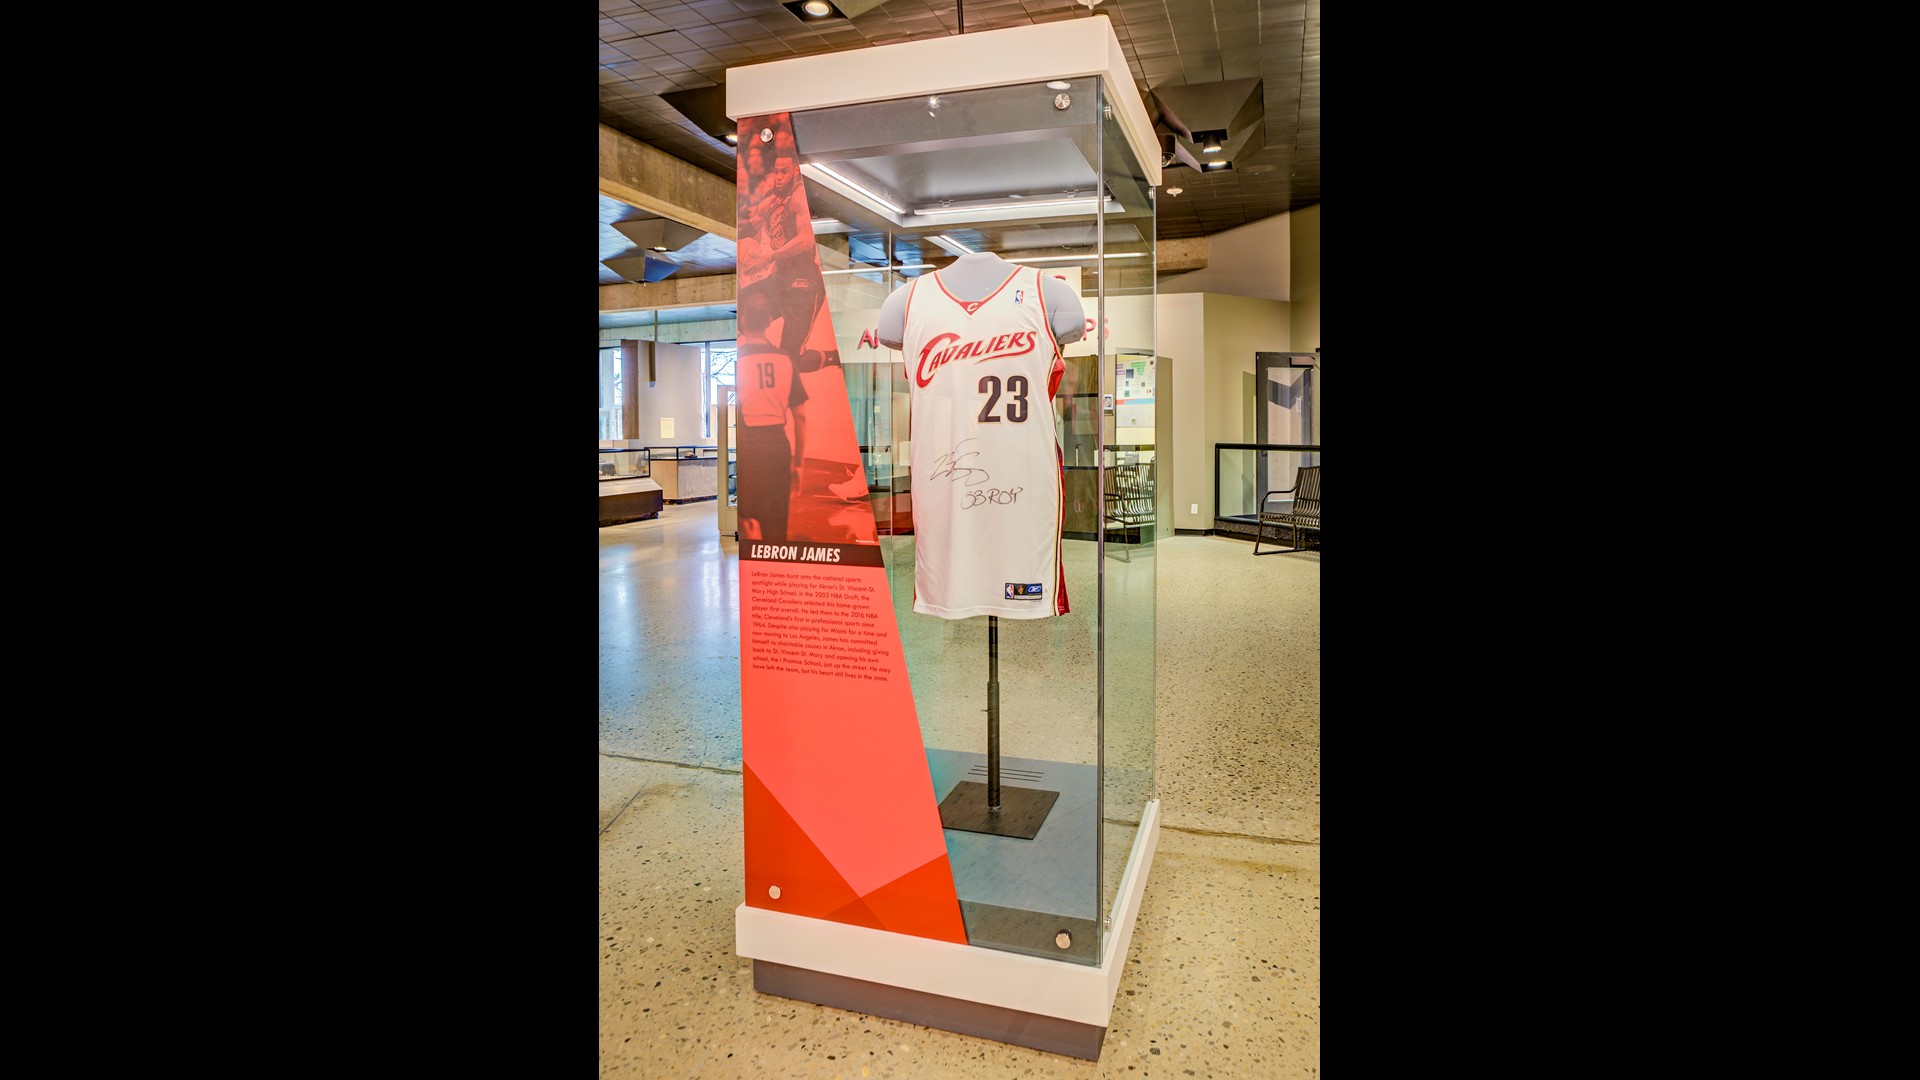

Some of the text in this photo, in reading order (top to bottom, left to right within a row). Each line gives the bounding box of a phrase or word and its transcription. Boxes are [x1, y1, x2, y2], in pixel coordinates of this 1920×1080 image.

[916, 331, 1037, 388] CAVALIERS
[756, 362, 775, 390] 19
[977, 375, 1029, 423] 23
[751, 544, 841, 563] LEBRON JAMES
[811, 618, 843, 626] professional
